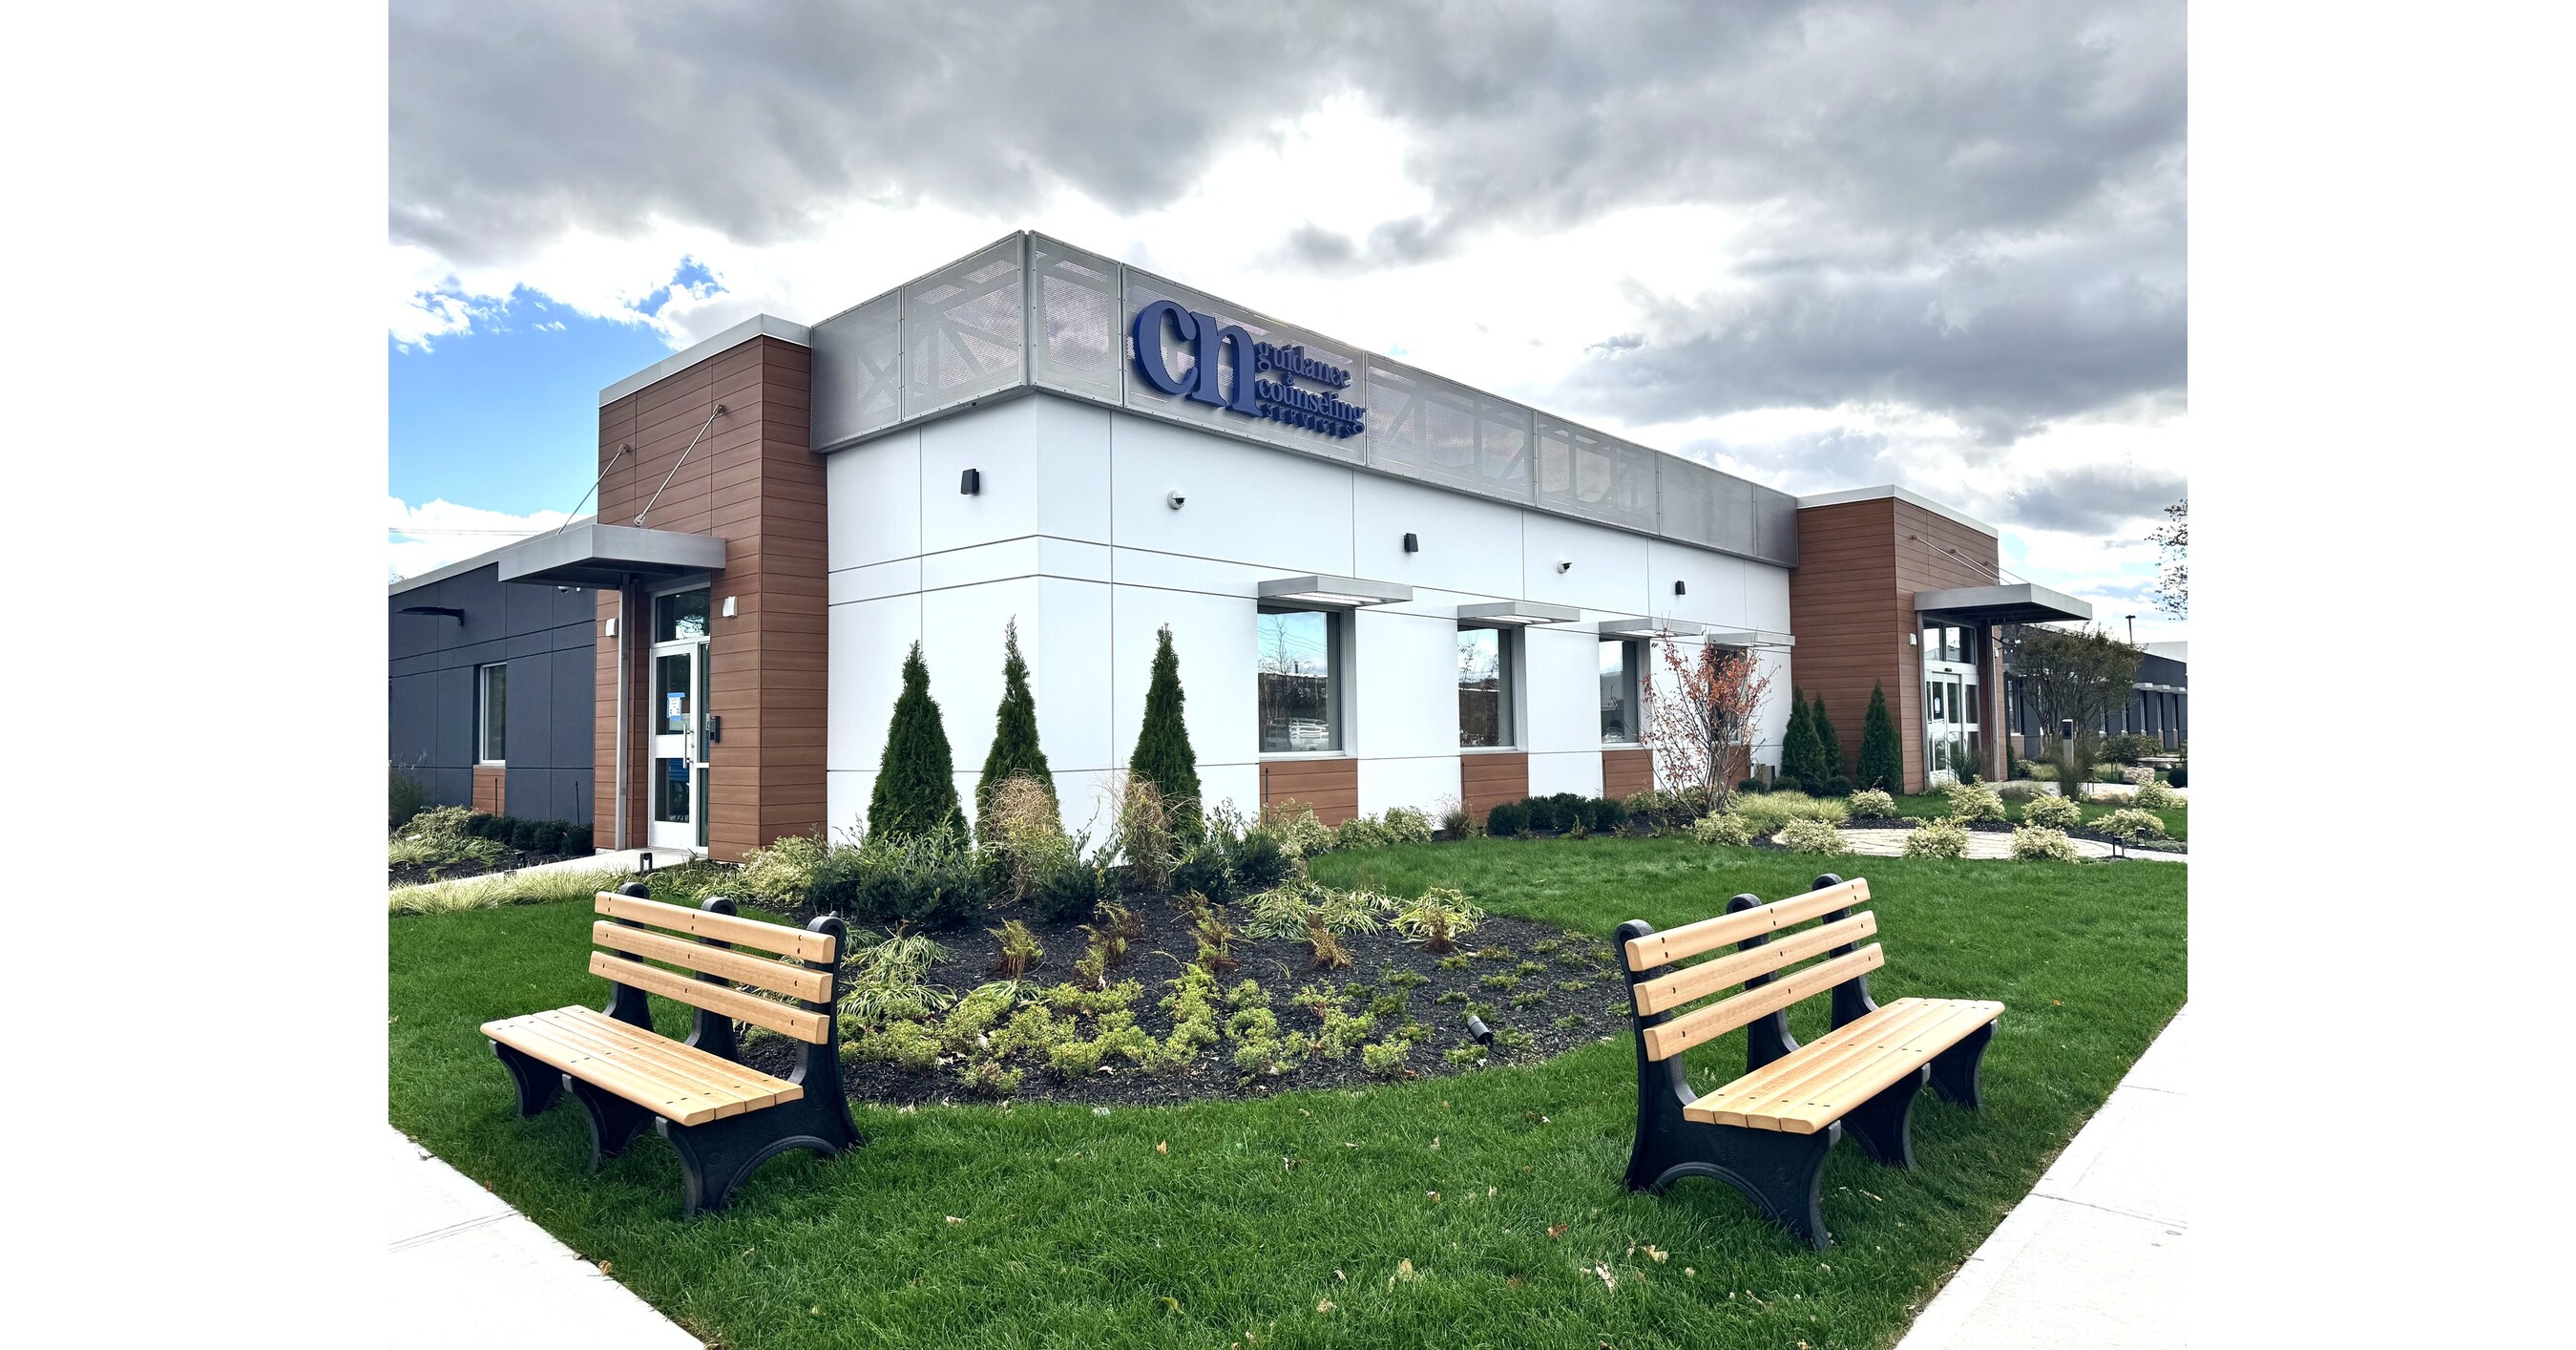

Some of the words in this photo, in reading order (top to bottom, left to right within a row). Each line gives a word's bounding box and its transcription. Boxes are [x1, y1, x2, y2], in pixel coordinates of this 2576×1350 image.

[1134, 300, 1263, 417] cn
[1256, 342, 1351, 388] guidance
[1258, 379, 1365, 432] counseling
[1265, 403, 1352, 438] SERVICES
